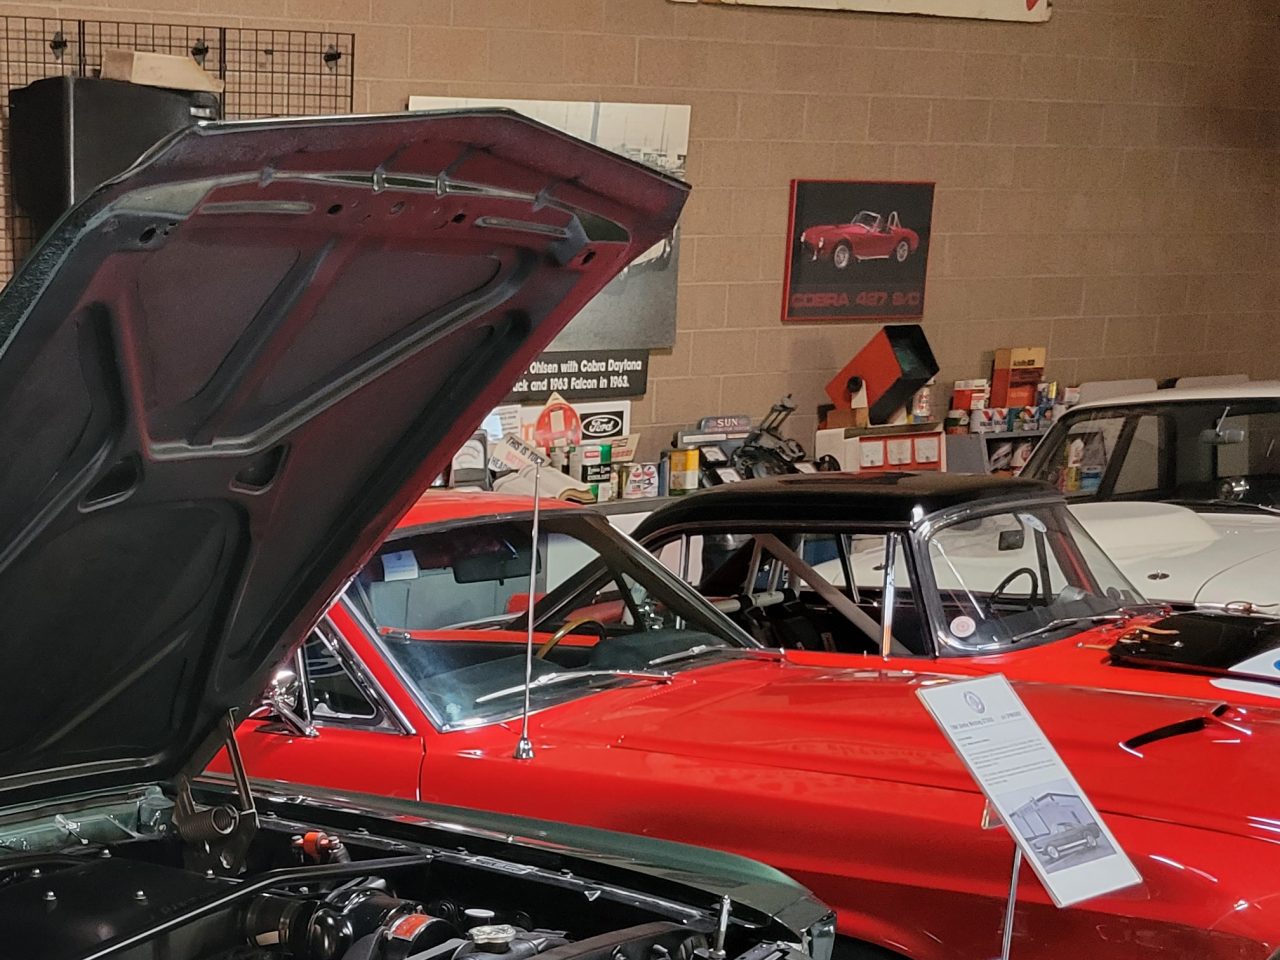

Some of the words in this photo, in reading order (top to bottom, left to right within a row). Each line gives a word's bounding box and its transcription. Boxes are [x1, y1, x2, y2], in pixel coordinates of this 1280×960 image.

[529, 361, 559, 374] Ohlsen
[580, 359, 606, 372] Cobra
[607, 358, 642, 374] Daytona
[530, 378, 548, 391] and
[550, 377, 569, 390] 1963
[570, 376, 598, 390] Falcon
[599, 375, 608, 389] in
[609, 374, 630, 388] 1963.
[588, 418, 615, 432] Ford
[717, 418, 738, 427] SUN
